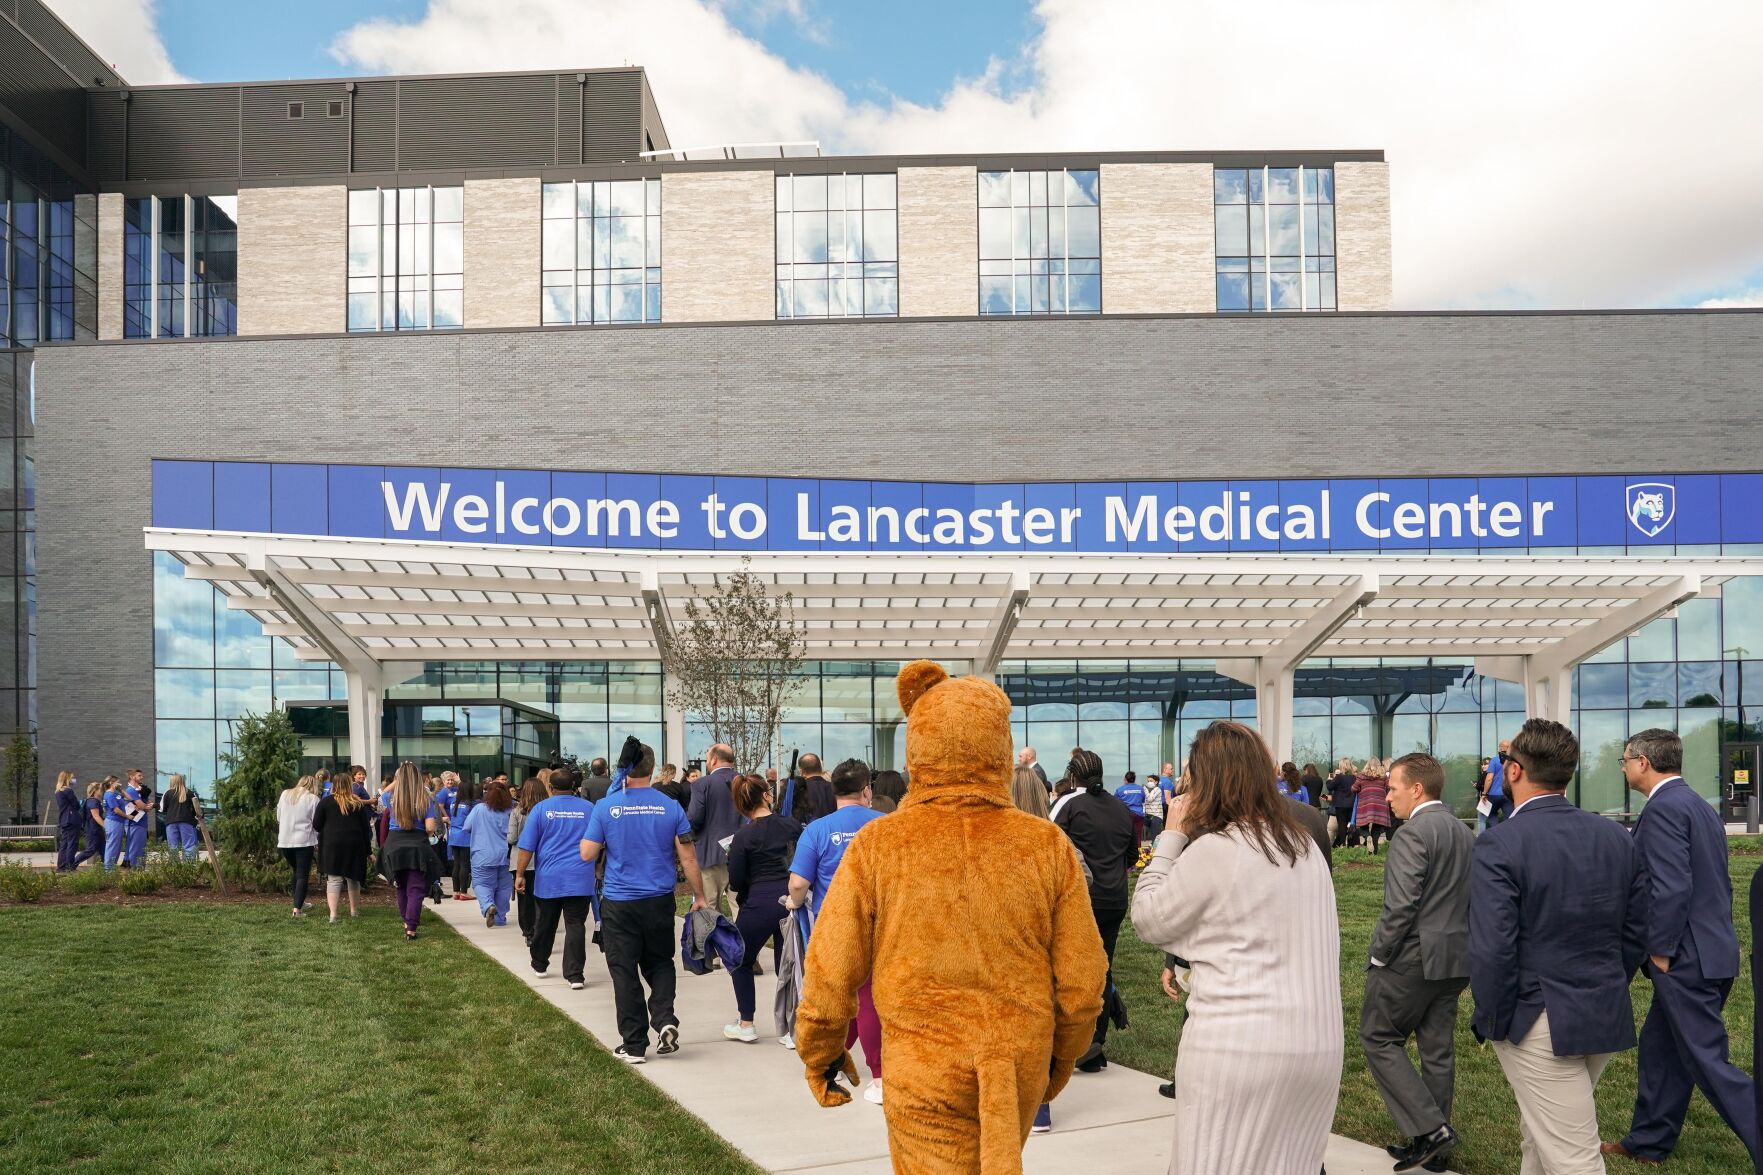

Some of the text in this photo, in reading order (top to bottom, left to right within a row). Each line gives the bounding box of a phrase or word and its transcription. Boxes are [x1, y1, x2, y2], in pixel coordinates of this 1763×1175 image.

[381, 481, 1554, 545] Welcome to Lancaster Medical Center
